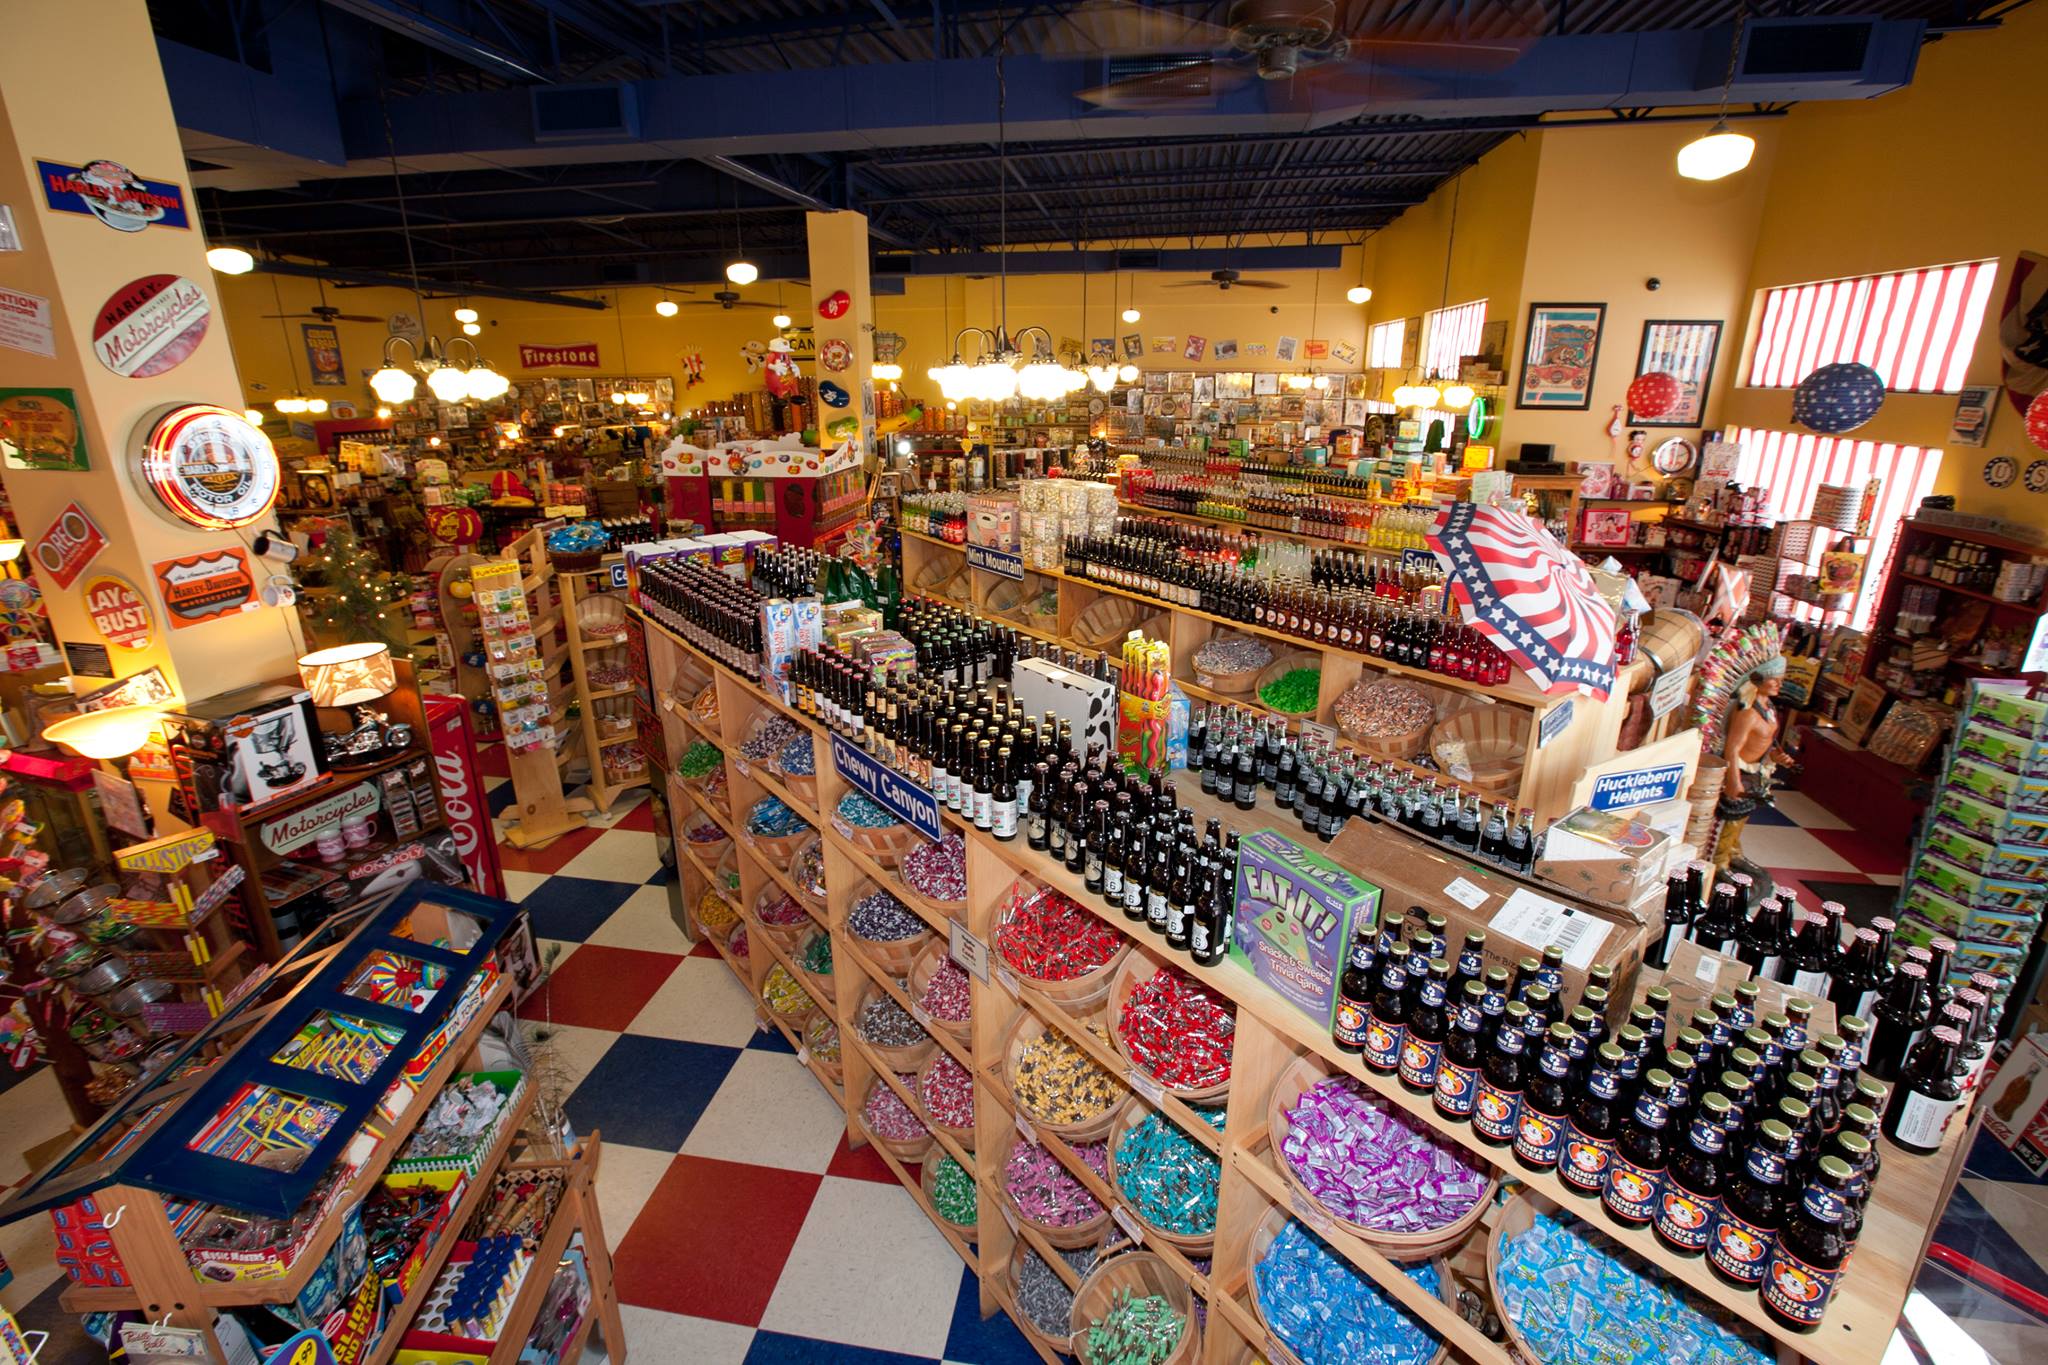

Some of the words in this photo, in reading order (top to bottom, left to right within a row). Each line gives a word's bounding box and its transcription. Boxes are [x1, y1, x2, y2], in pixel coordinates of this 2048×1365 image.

[104, 285, 201, 368] Motorcycles
[522, 348, 597, 366] Firestone
[38, 511, 89, 572] OREO
[968, 547, 985, 566] Mint
[985, 553, 1023, 577] Mountain
[86, 587, 121, 613] LAY
[95, 606, 147, 634] BUST
[834, 742, 877, 794] Chewy
[881, 773, 937, 829] Canyon
[1597, 768, 1682, 793] Huckleberry
[1608, 786, 1664, 806] Heights
[270, 791, 376, 848] Motorcycles
[350, 844, 425, 879] MONOPOLY
[1242, 865, 1293, 910] EAT
[1294, 888, 1338, 941] IT!
[1258, 940, 1290, 966] Snacks
[1296, 960, 1332, 985] Sweets
[1270, 959, 1295, 980] Trivia
[1296, 973, 1324, 996] Game
[1516, 1142, 1544, 1161] BEER
[1517, 1136, 1546, 1155] ROOT
[1567, 1170, 1598, 1187] BEER
[1568, 1164, 1600, 1180] ROOT
[1608, 1198, 1641, 1217] BEER
[1610, 1191, 1643, 1211] ROOT
[1660, 1222, 1694, 1245] BEER
[1661, 1216, 1696, 1238] ROOT
[201, 1250, 231, 1262] MUSIC
[232, 1251, 265, 1262] MAKERS
[1715, 1254, 1751, 1278] BEER
[1716, 1248, 1753, 1271] ROOT
[1768, 1292, 1806, 1319] BEER
[1770, 1285, 1809, 1311] ROOT
